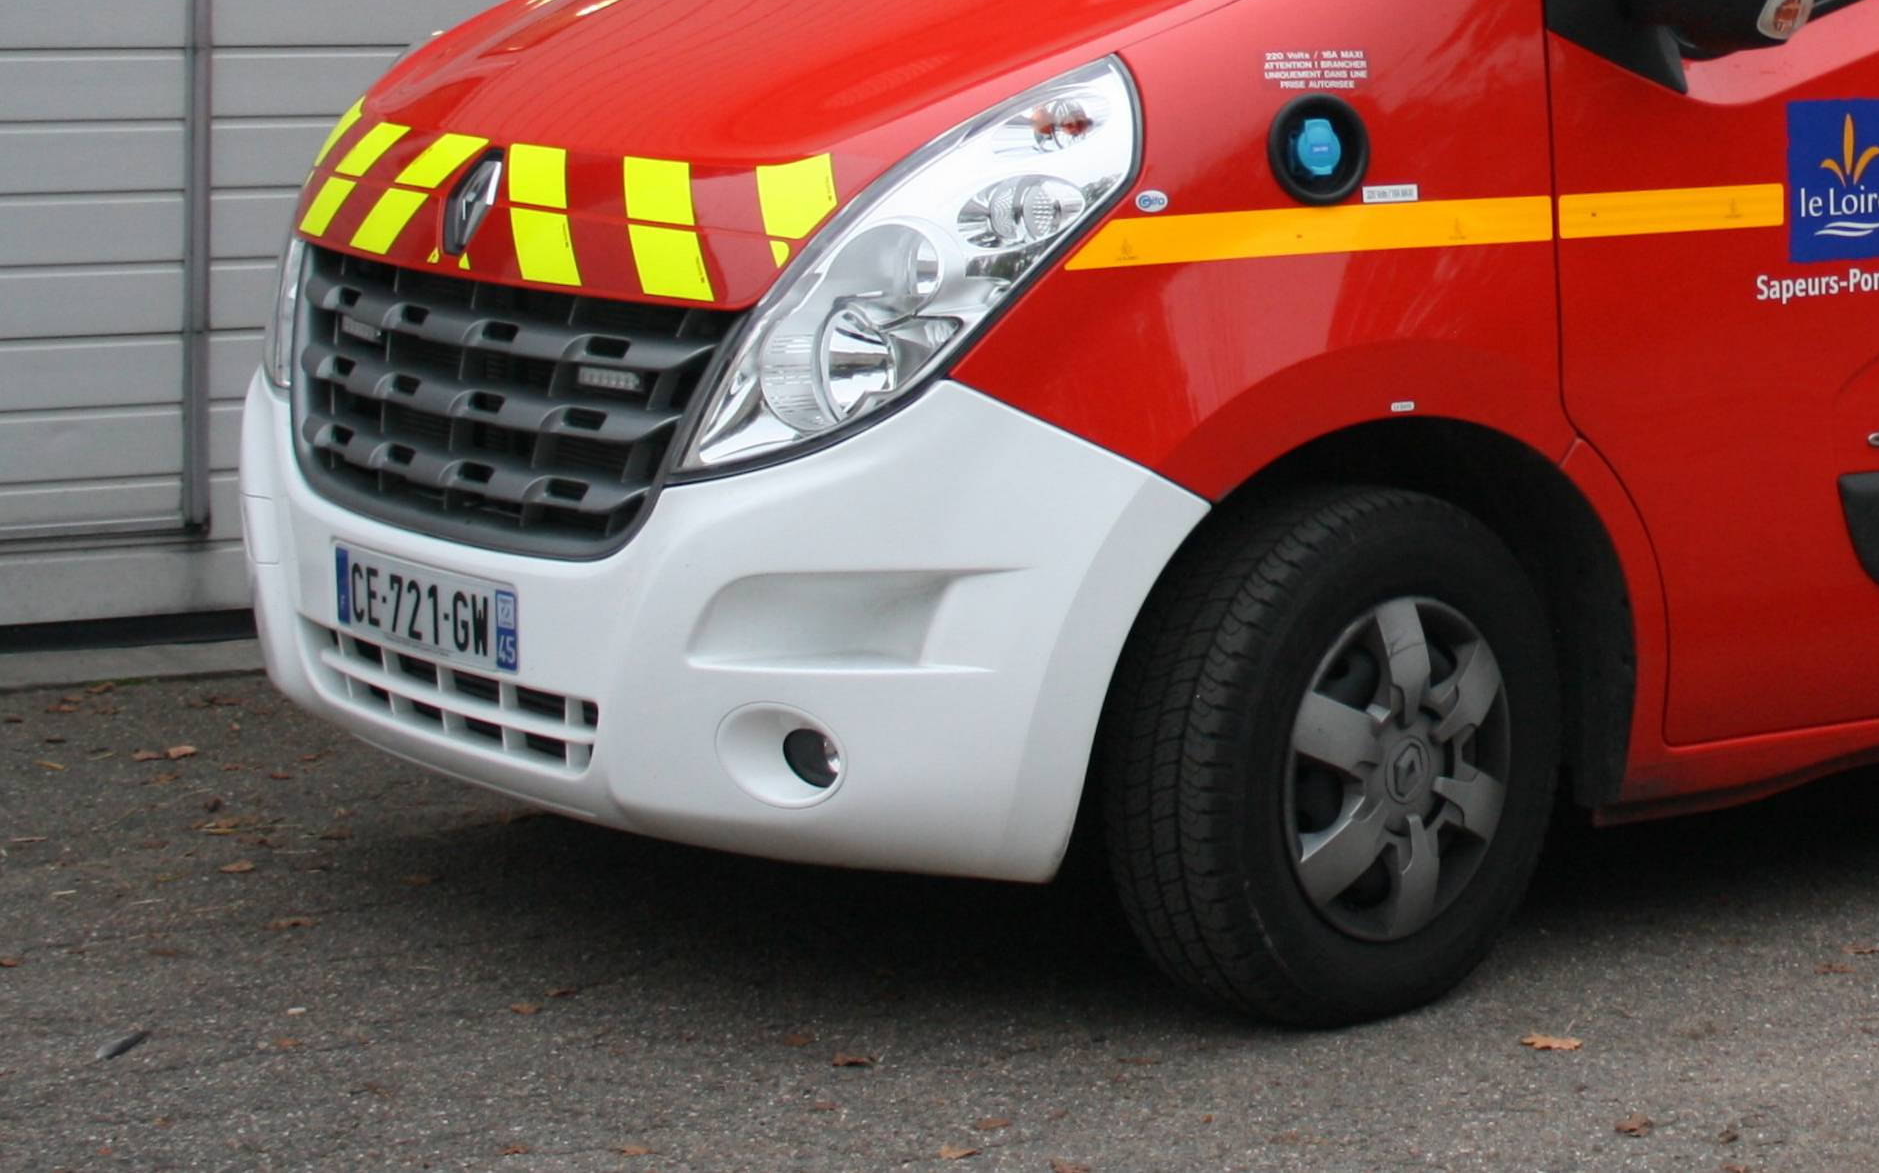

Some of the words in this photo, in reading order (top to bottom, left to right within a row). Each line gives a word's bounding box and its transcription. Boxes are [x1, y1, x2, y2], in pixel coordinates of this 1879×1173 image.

[1264, 61, 1313, 70] ATTENTION
[1264, 70, 1321, 79] UNIQUEMENT
[1800, 187, 1823, 218] le
[351, 562, 489, 657] CE-721-GW
[498, 635, 515, 664] 45
